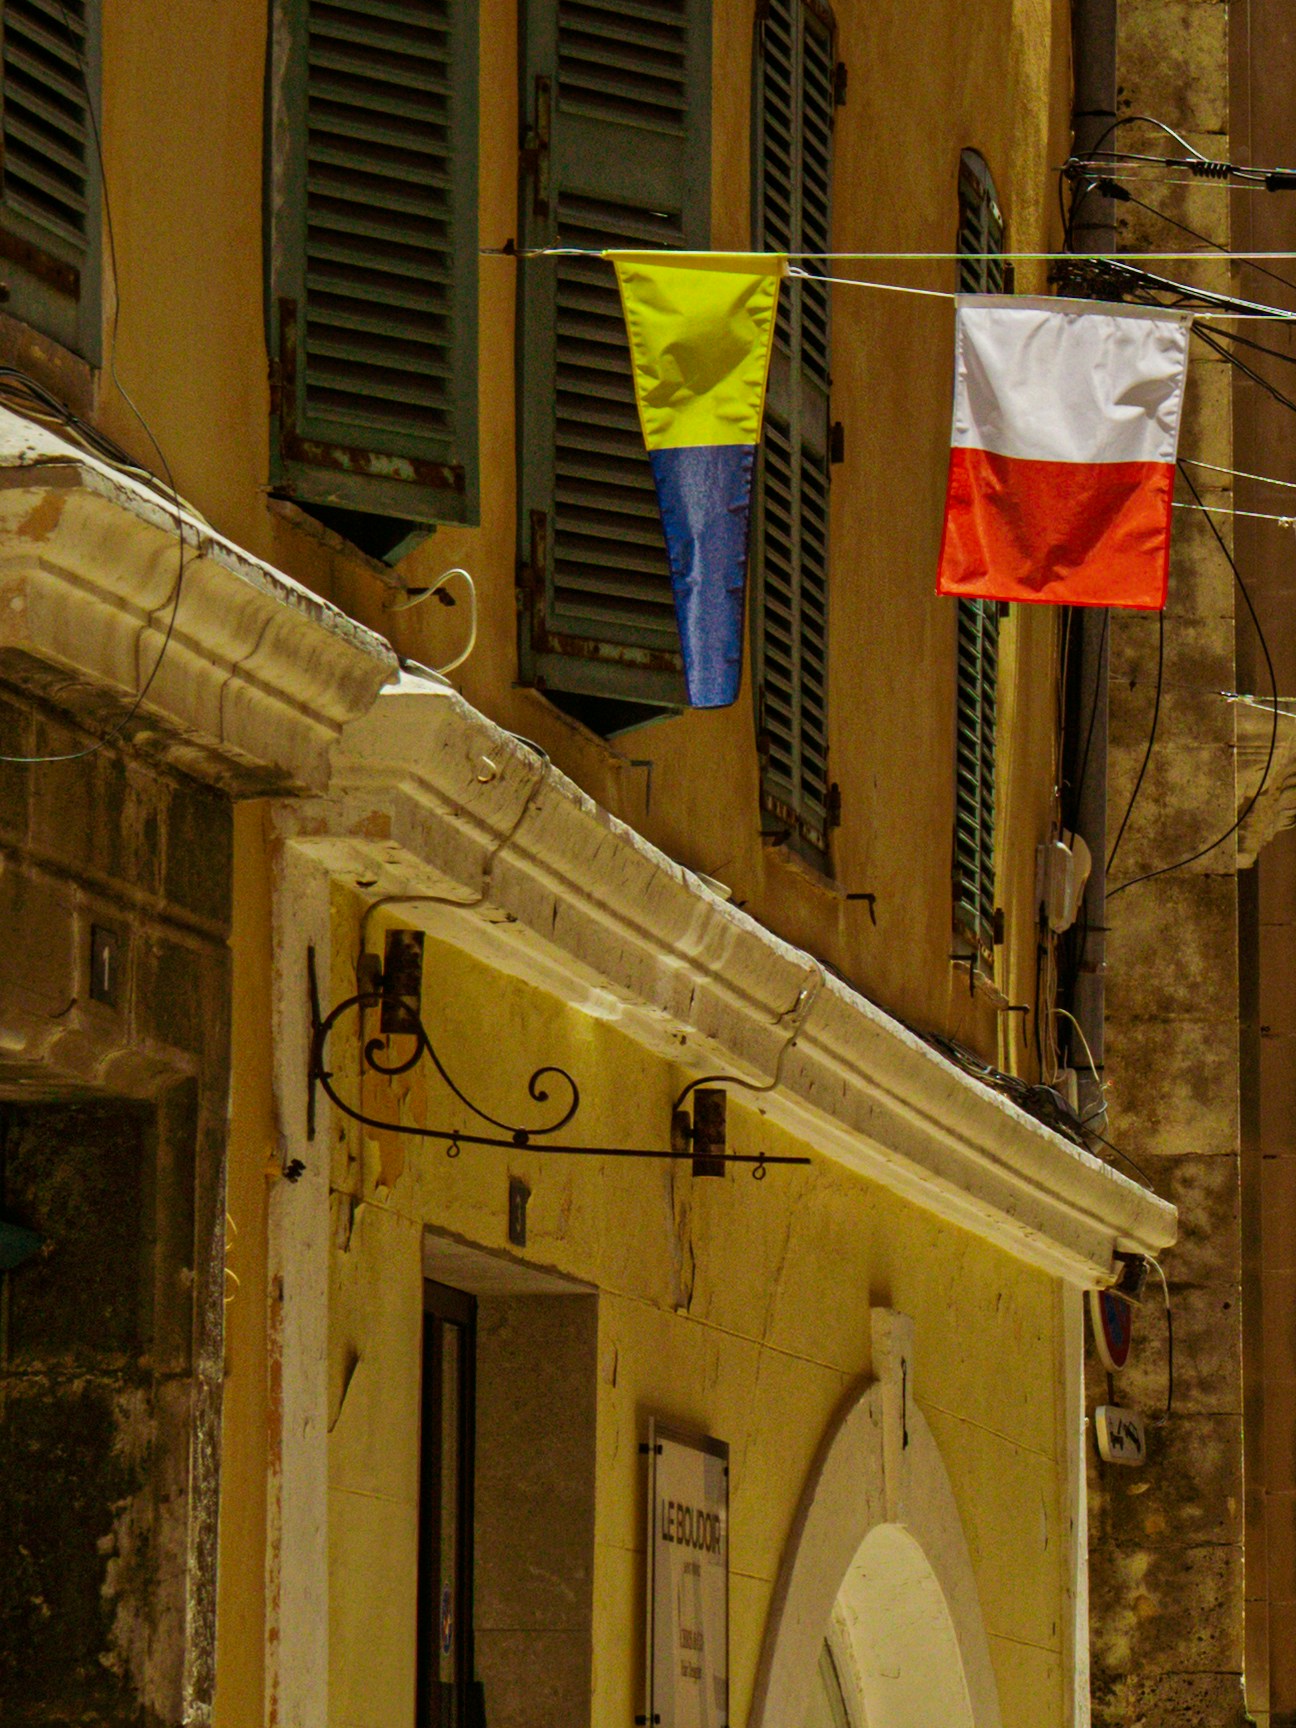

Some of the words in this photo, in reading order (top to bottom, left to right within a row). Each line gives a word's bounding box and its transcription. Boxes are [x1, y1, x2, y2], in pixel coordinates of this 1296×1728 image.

[102, 945, 110, 991] 1
[661, 1498, 675, 1543] LE
[676, 1502, 721, 1555] BOUDOIR
